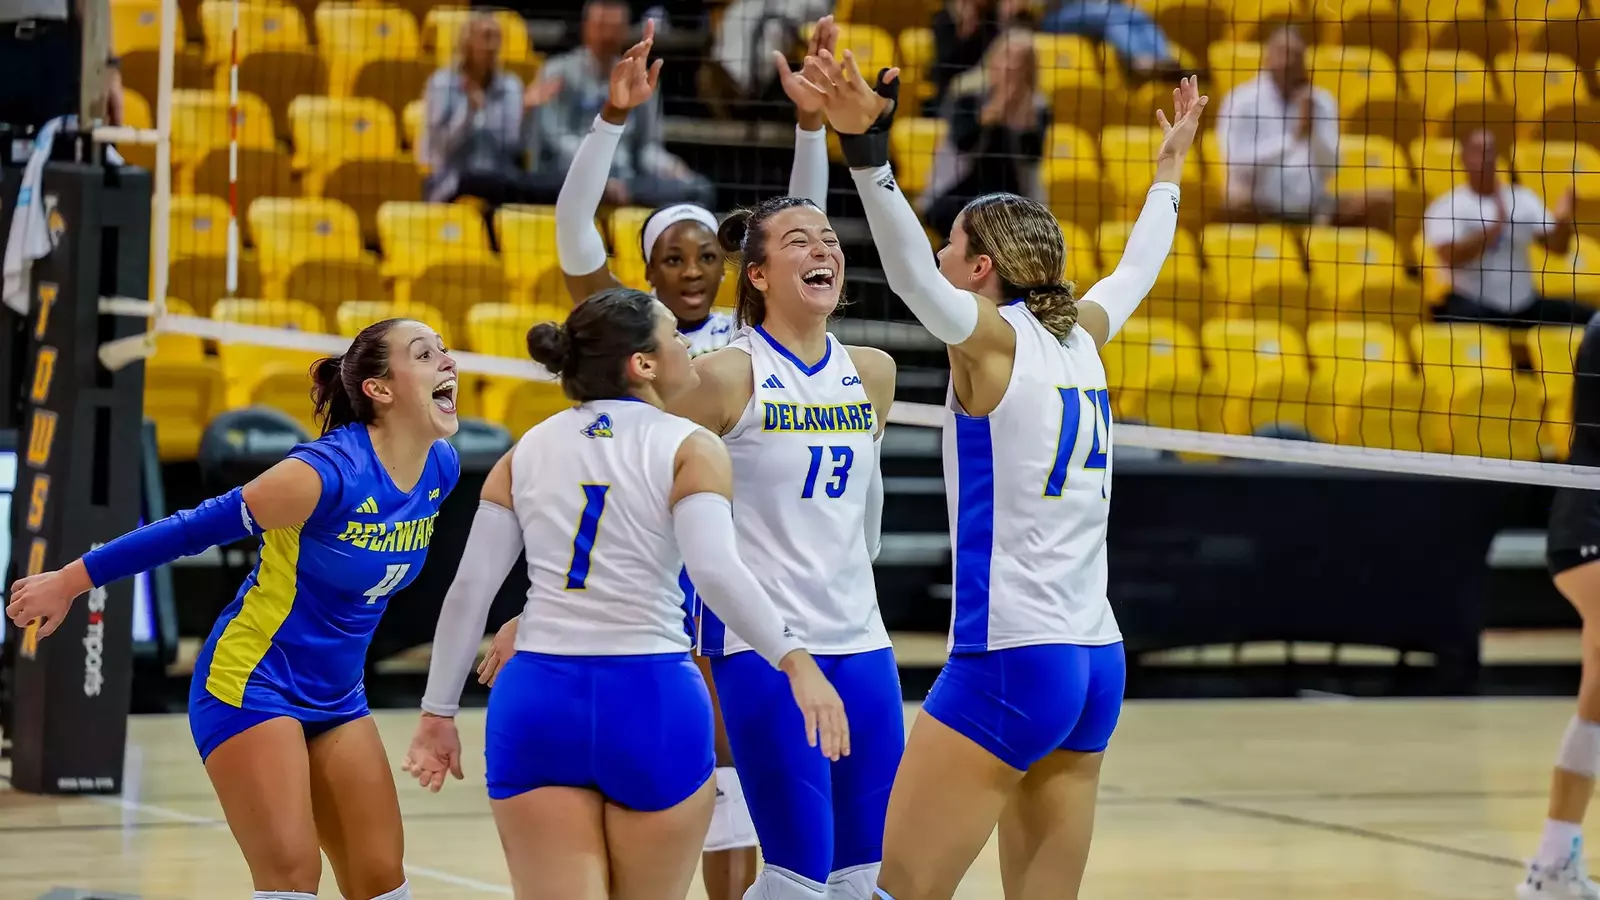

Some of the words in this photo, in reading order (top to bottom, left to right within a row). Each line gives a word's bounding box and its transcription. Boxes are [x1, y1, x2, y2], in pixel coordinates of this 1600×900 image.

[761, 400, 873, 433] DELAWARE
[1042, 385, 1109, 501] 14
[801, 445, 854, 499] 13
[337, 510, 439, 552] DELAWAR
[564, 481, 612, 592] 1
[363, 564, 411, 604] 4
